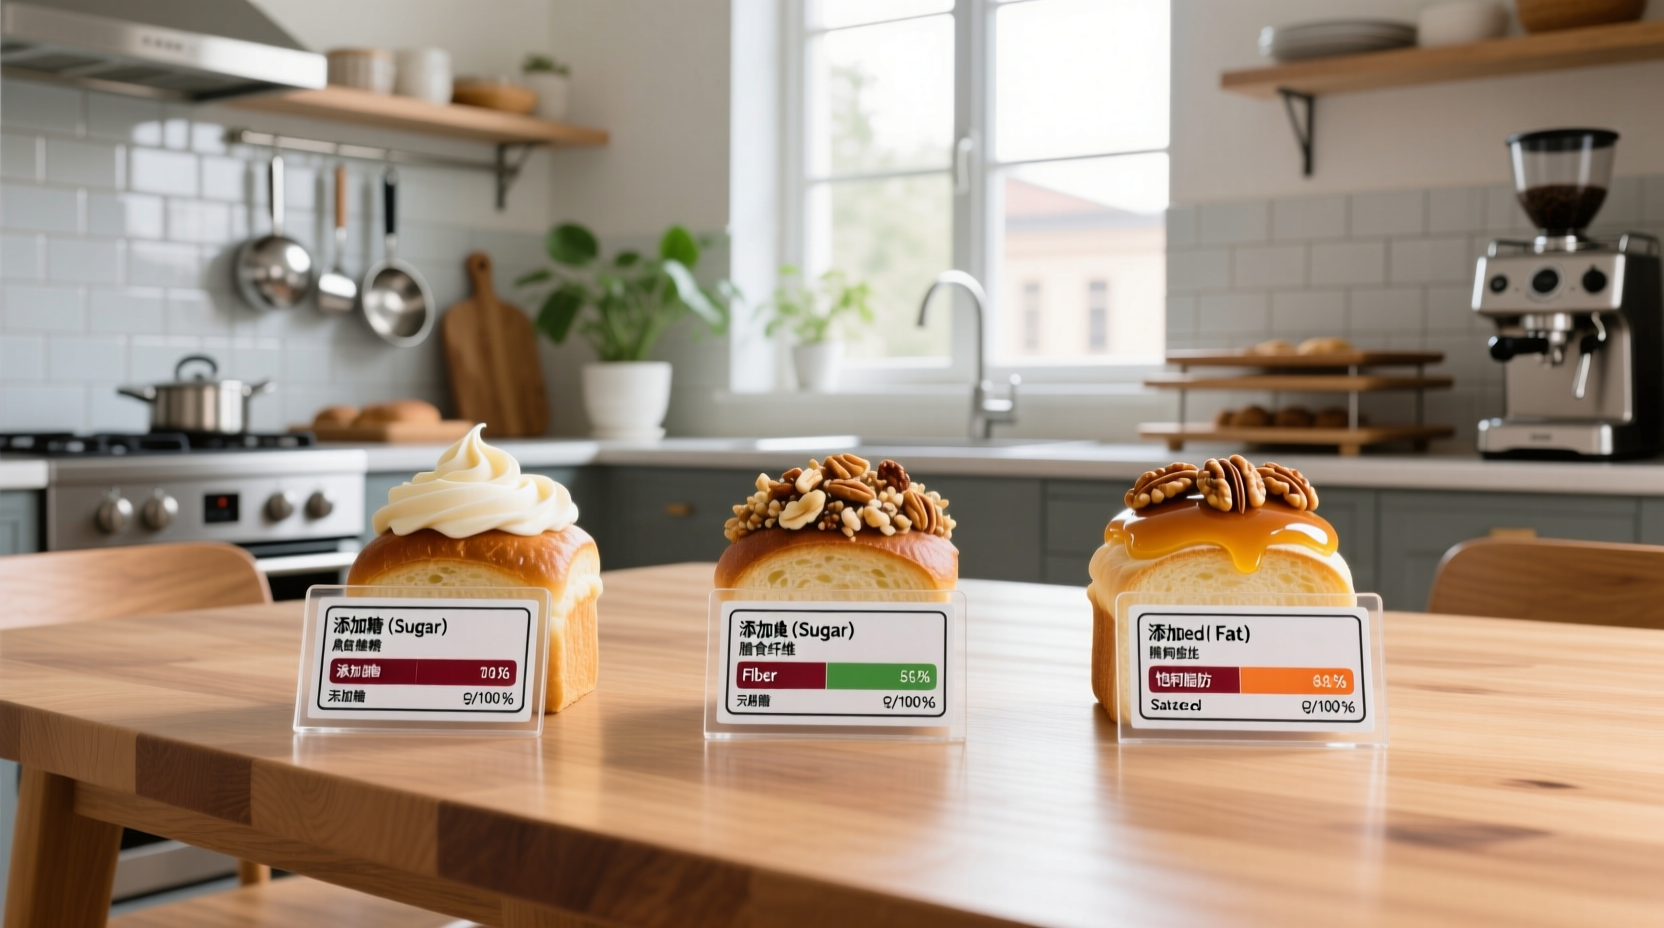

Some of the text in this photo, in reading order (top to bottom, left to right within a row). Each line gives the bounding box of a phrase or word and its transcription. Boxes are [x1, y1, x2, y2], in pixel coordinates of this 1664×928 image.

[388, 617, 448, 637] (Sugar)
[792, 621, 854, 641] (Sugar)
[742, 667, 777, 682] Fiber
